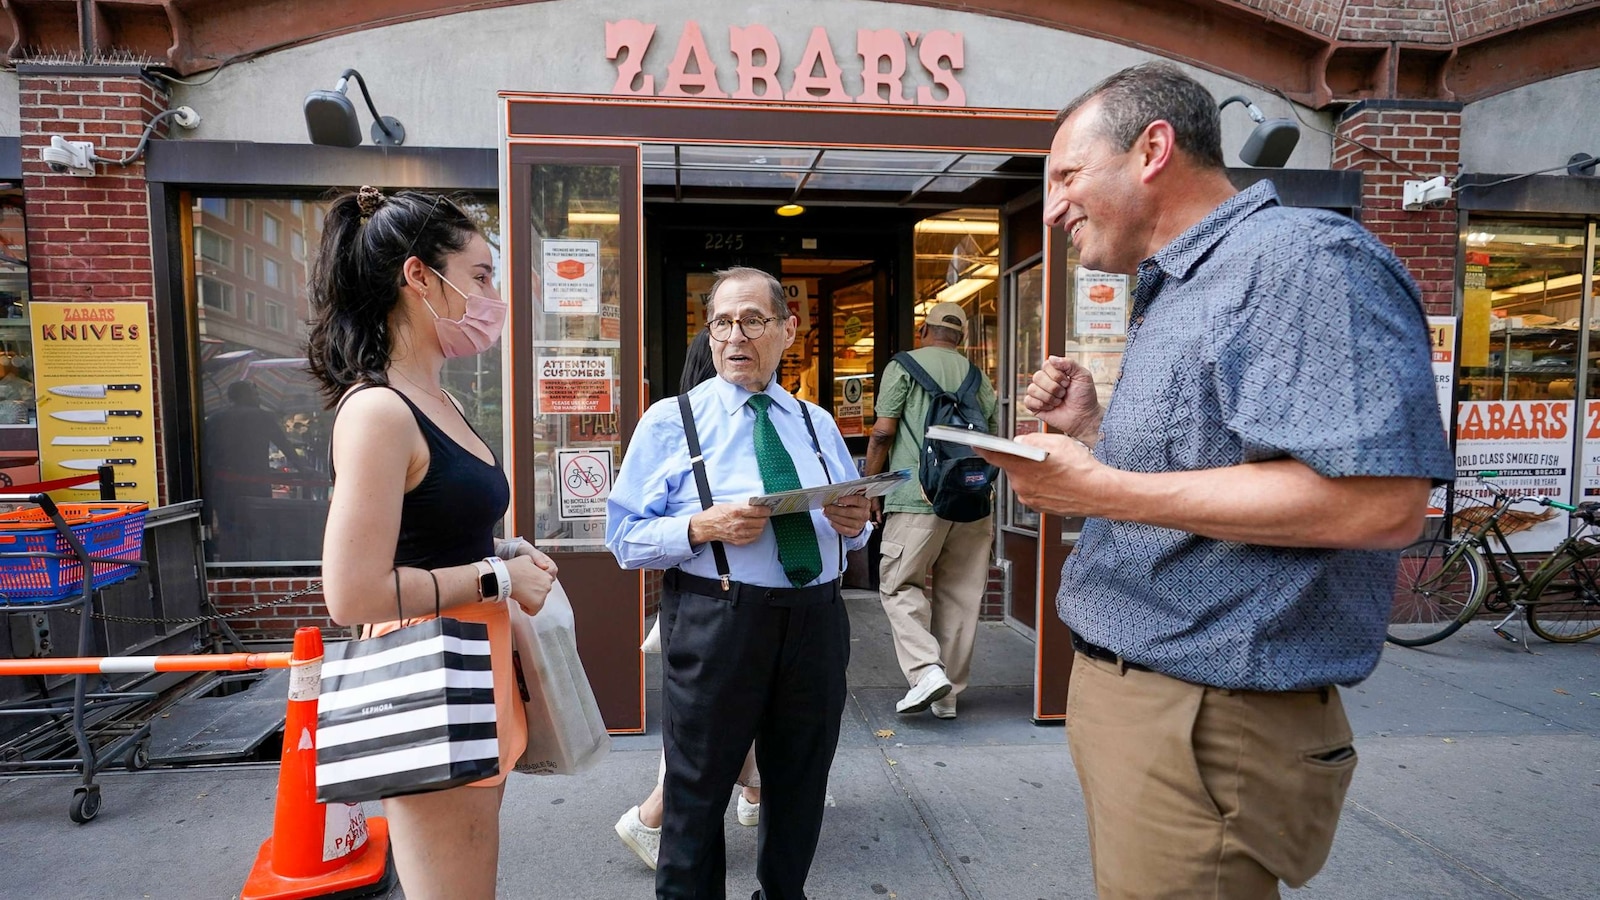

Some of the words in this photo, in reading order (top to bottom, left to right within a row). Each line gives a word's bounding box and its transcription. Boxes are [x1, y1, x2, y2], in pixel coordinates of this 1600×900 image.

[605, 19, 966, 107] ZABAR'S
[705, 232, 744, 250] 2245
[63, 308, 115, 322] ZABAR'S
[42, 324, 140, 340] KNIVES
[544, 360, 605, 369] ATTENTION
[1457, 454, 1477, 467] ORLD
[1480, 453, 1504, 465] CLASS
[1506, 453, 1538, 464] SMOKED
[1541, 455, 1559, 466] FISH
[1538, 488, 1560, 496] WORLD
[584, 523, 597, 531] UP
[362, 703, 393, 715] SEPHORA
